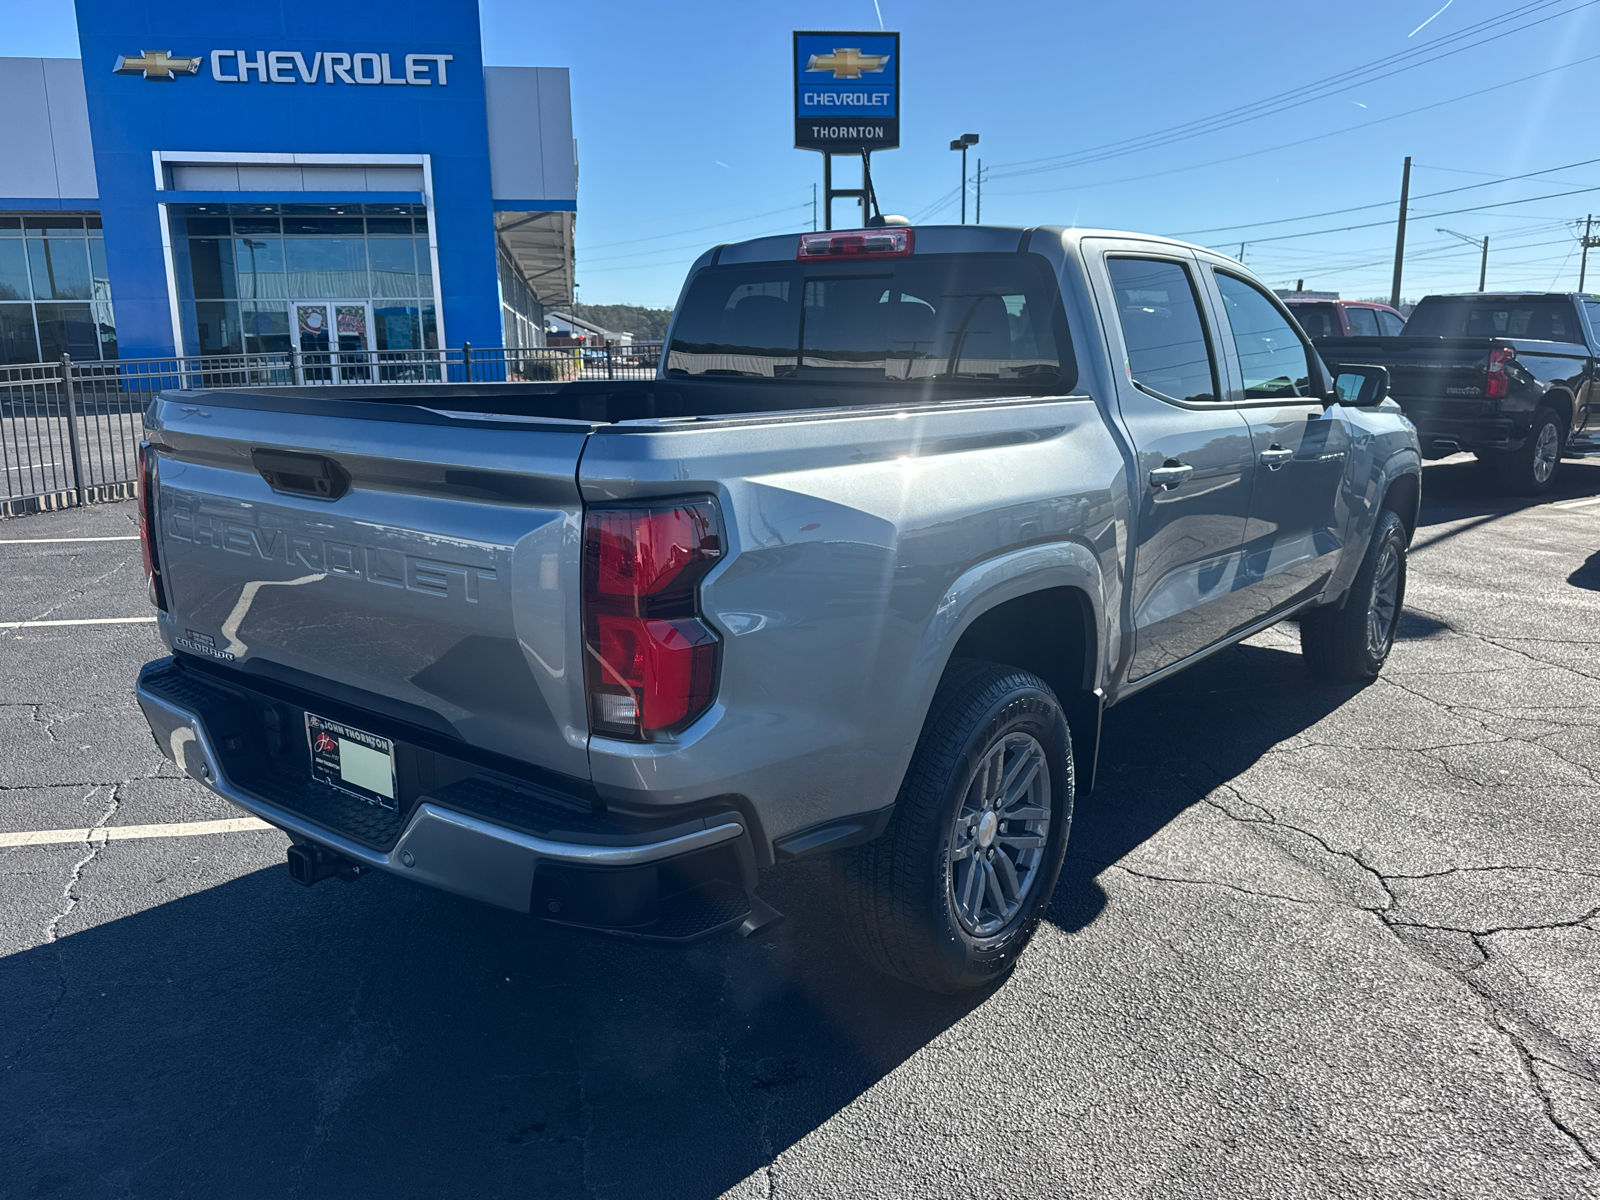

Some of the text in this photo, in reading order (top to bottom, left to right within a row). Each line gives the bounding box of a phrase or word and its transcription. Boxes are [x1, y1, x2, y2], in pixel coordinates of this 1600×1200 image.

[210, 49, 453, 86] CHEVROLET
[804, 92, 890, 106] CHEVROLET
[812, 126, 883, 138] THORNTON
[168, 511, 498, 604] CHEVROLET
[175, 636, 235, 662] COLORADO
[324, 720, 345, 736] JOHN
[345, 728, 388, 751] THORNTON
